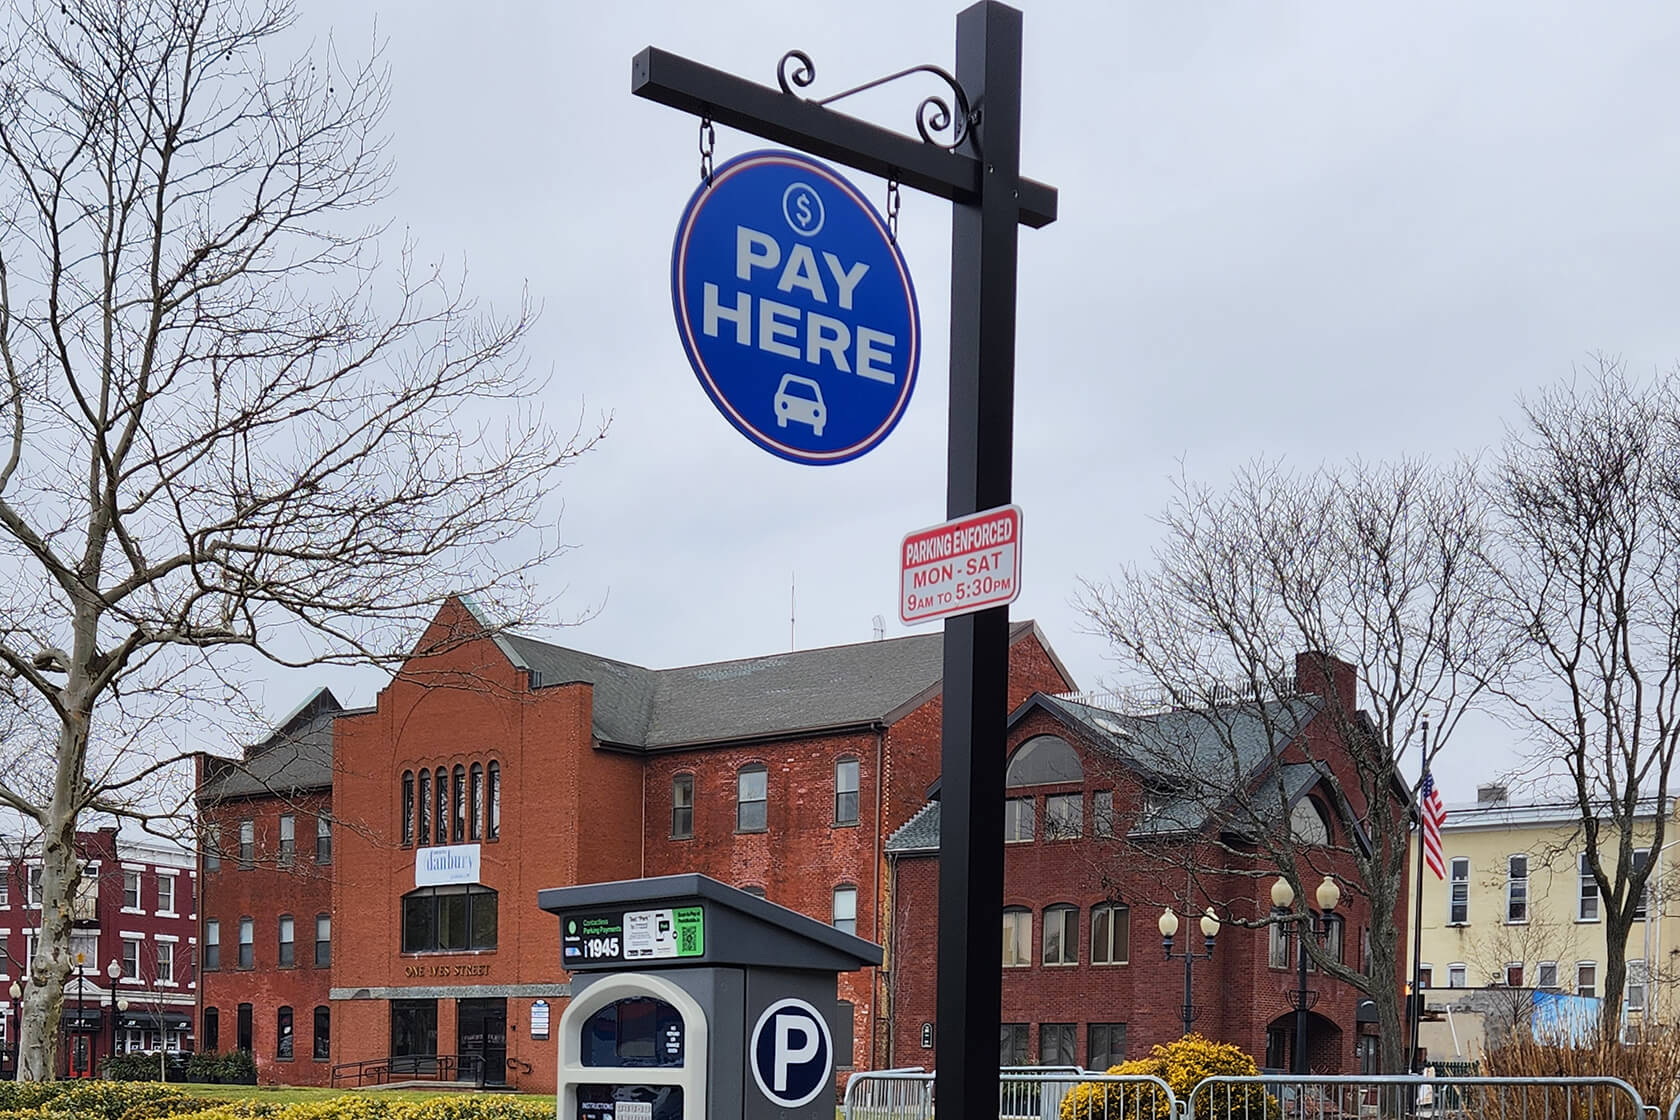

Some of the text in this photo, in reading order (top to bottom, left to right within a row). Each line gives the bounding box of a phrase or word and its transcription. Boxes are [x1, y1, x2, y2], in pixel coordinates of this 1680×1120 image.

[737, 225, 870, 311] PAY
[702, 281, 896, 385] HERE
[906, 518, 1013, 566] PARKING ENFORCED
[913, 563, 953, 589] MON
[966, 551, 1003, 576] SAT
[907, 576, 1011, 611] 9AM TO 5:30PM
[426, 849, 473, 872] danbury
[583, 927, 600, 935] Parking
[583, 937, 620, 958] i1945
[405, 964, 490, 977] ONE IVES STREET
[773, 1014, 820, 1092] P
